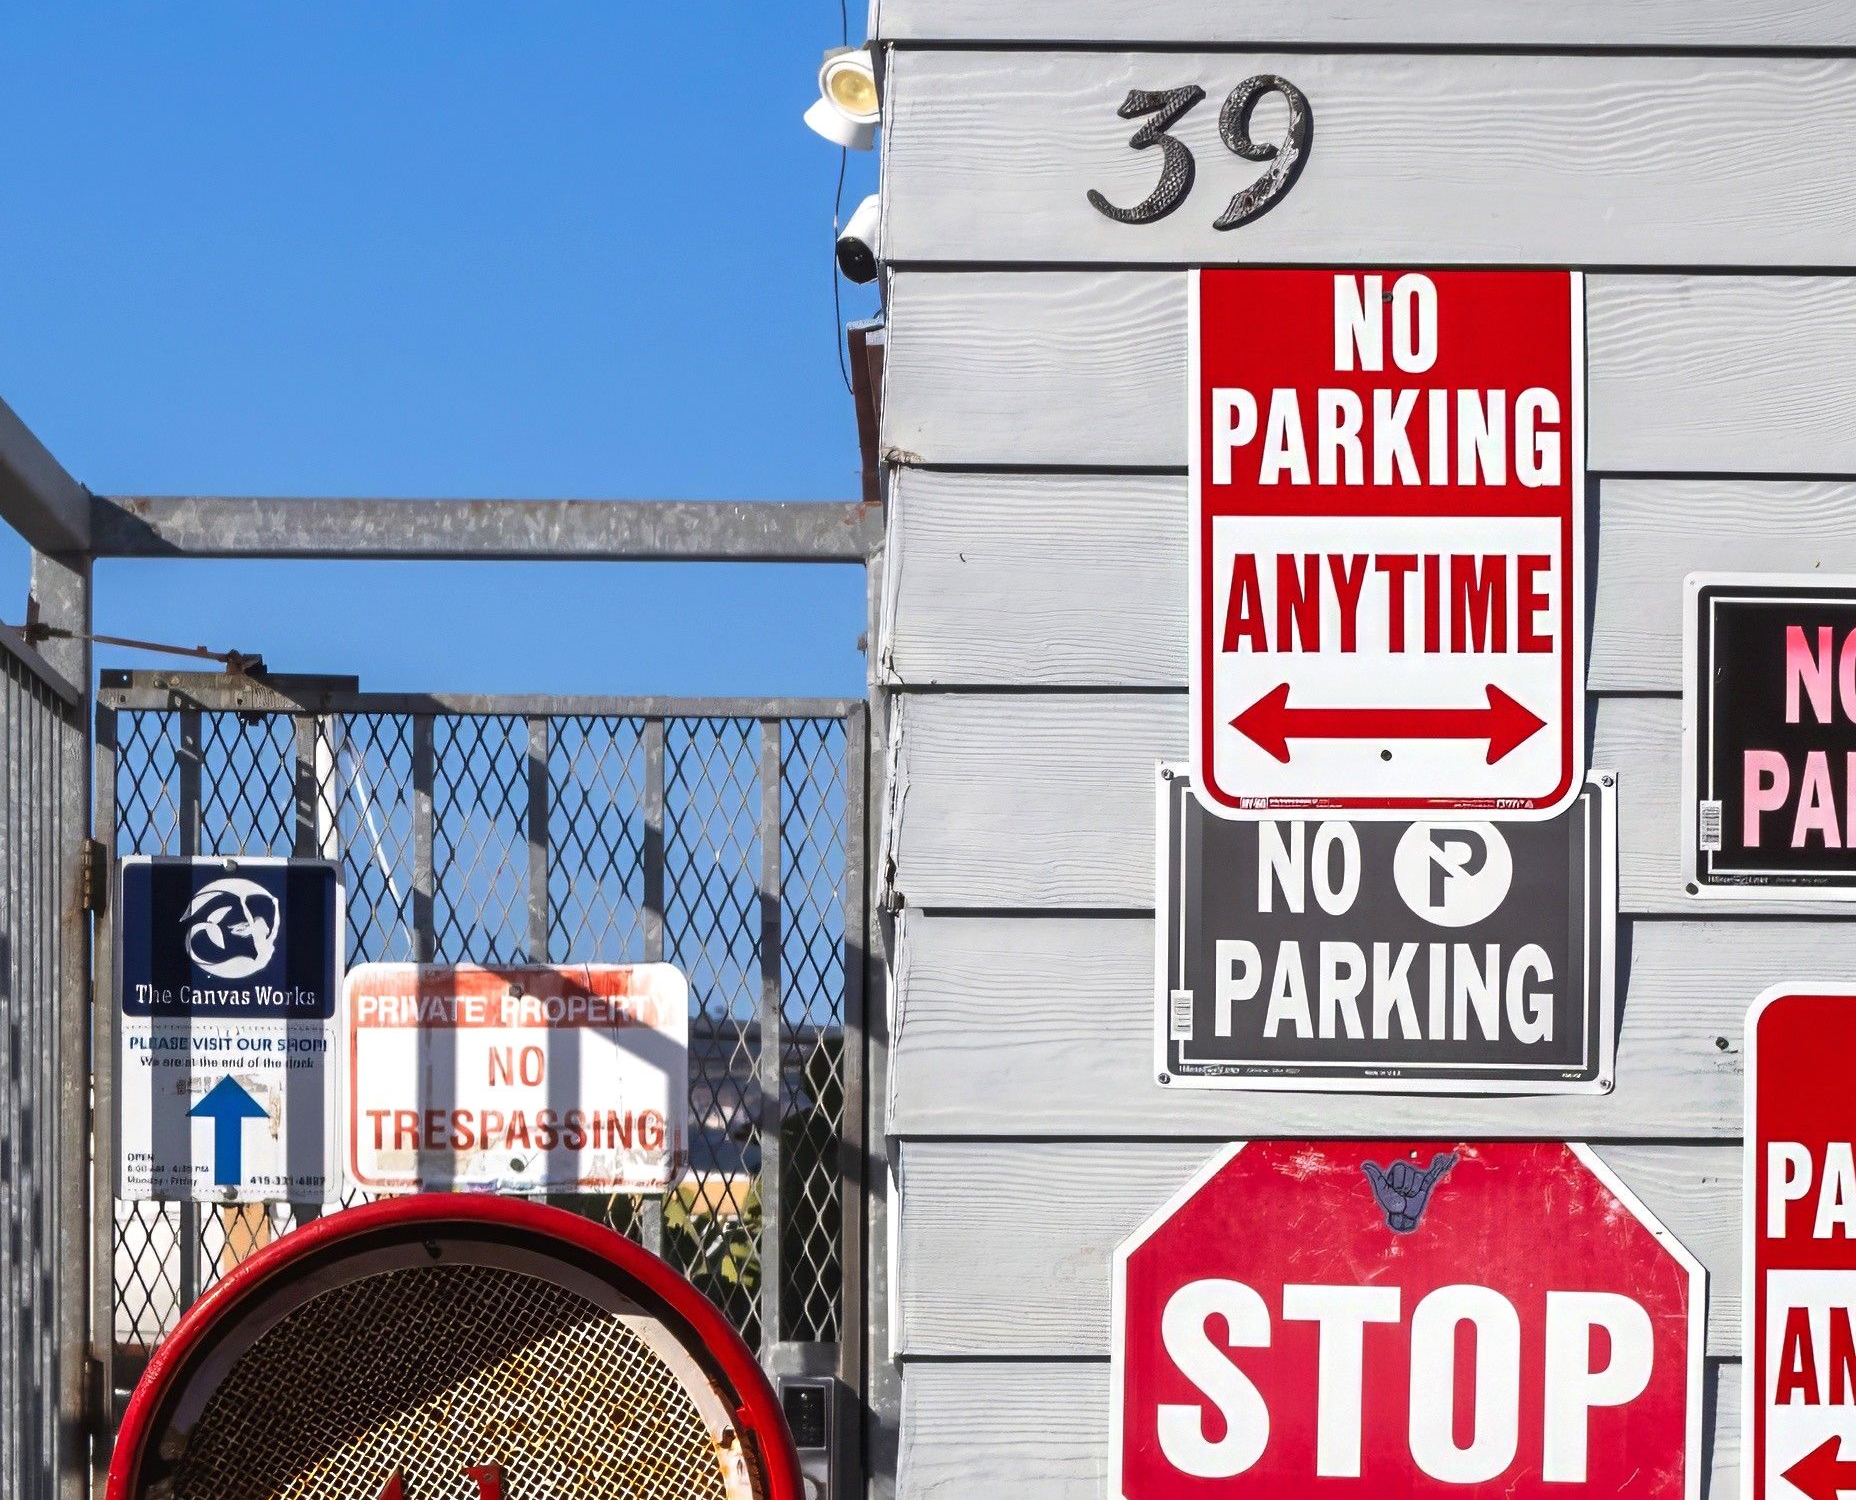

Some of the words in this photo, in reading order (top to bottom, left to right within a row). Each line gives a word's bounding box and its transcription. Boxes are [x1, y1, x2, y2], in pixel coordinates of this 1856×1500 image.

[1087, 75, 1314, 231] 39
[1334, 273, 1437, 373] NO
[1213, 388, 1560, 487] PARKING
[1222, 554, 1553, 653] ANYTIME
[1258, 822, 1361, 915] NO
[136, 984, 172, 1004] The
[180, 986, 250, 1006] Canvas
[255, 986, 315, 1006] Works
[358, 995, 486, 1023] PRIVATE
[501, 995, 669, 1023] PROPERTY
[1215, 940, 1553, 1044] PARKING
[130, 1037, 188, 1050] PLEASE
[192, 1037, 232, 1051] VISIT
[237, 1038, 272, 1051] OUR
[489, 1045, 545, 1087] NO
[366, 1108, 666, 1152] TRESPASSING
[1157, 1279, 1654, 1483] STOP
